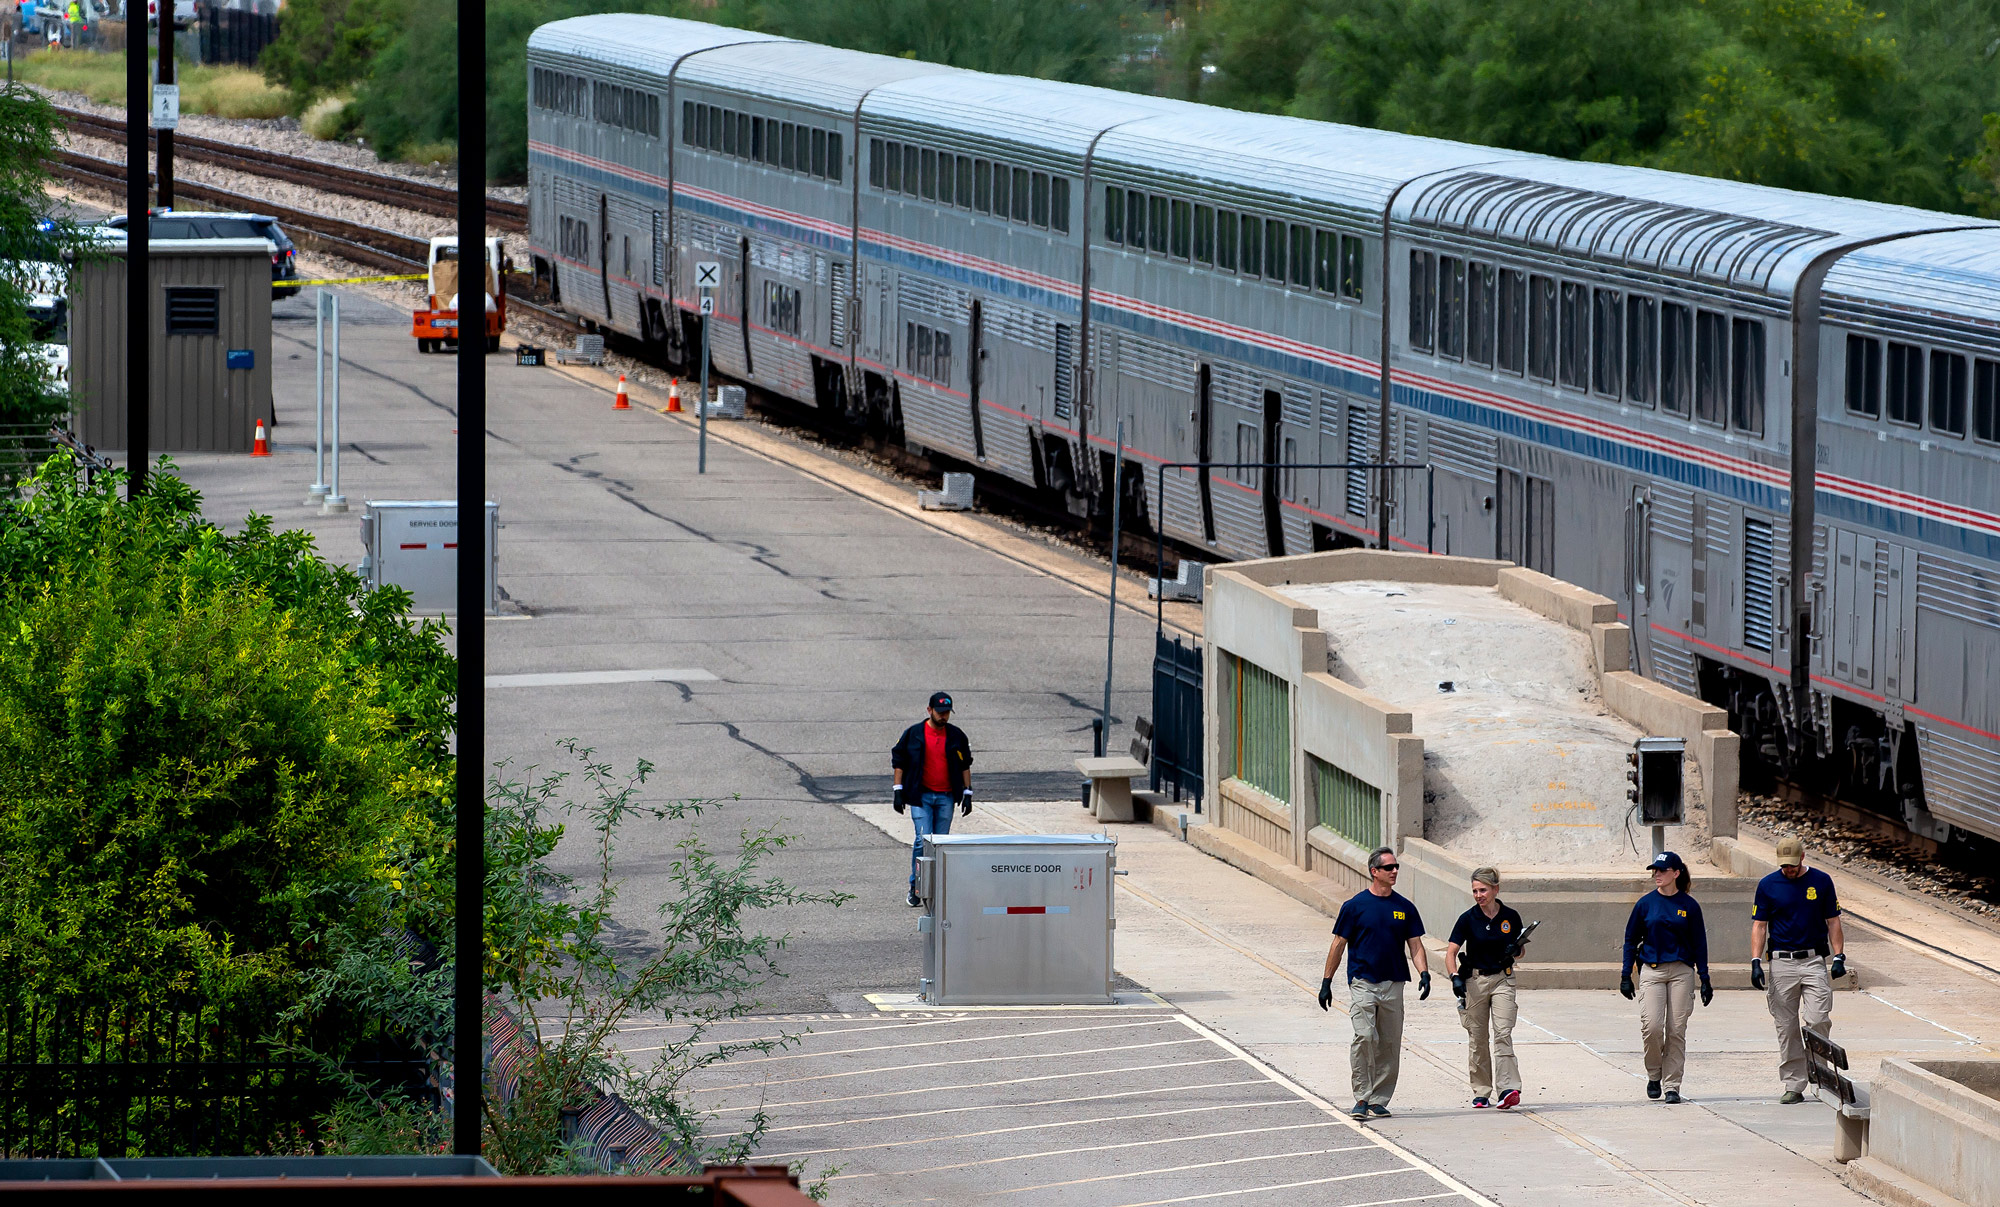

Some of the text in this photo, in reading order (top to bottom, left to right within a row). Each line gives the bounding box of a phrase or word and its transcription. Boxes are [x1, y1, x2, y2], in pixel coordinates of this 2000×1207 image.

[702, 299, 711, 312] 4
[409, 520, 438, 528] SERVICE
[991, 864, 1062, 873] SERVICE DOOR
[1393, 911, 1406, 920] FBI
